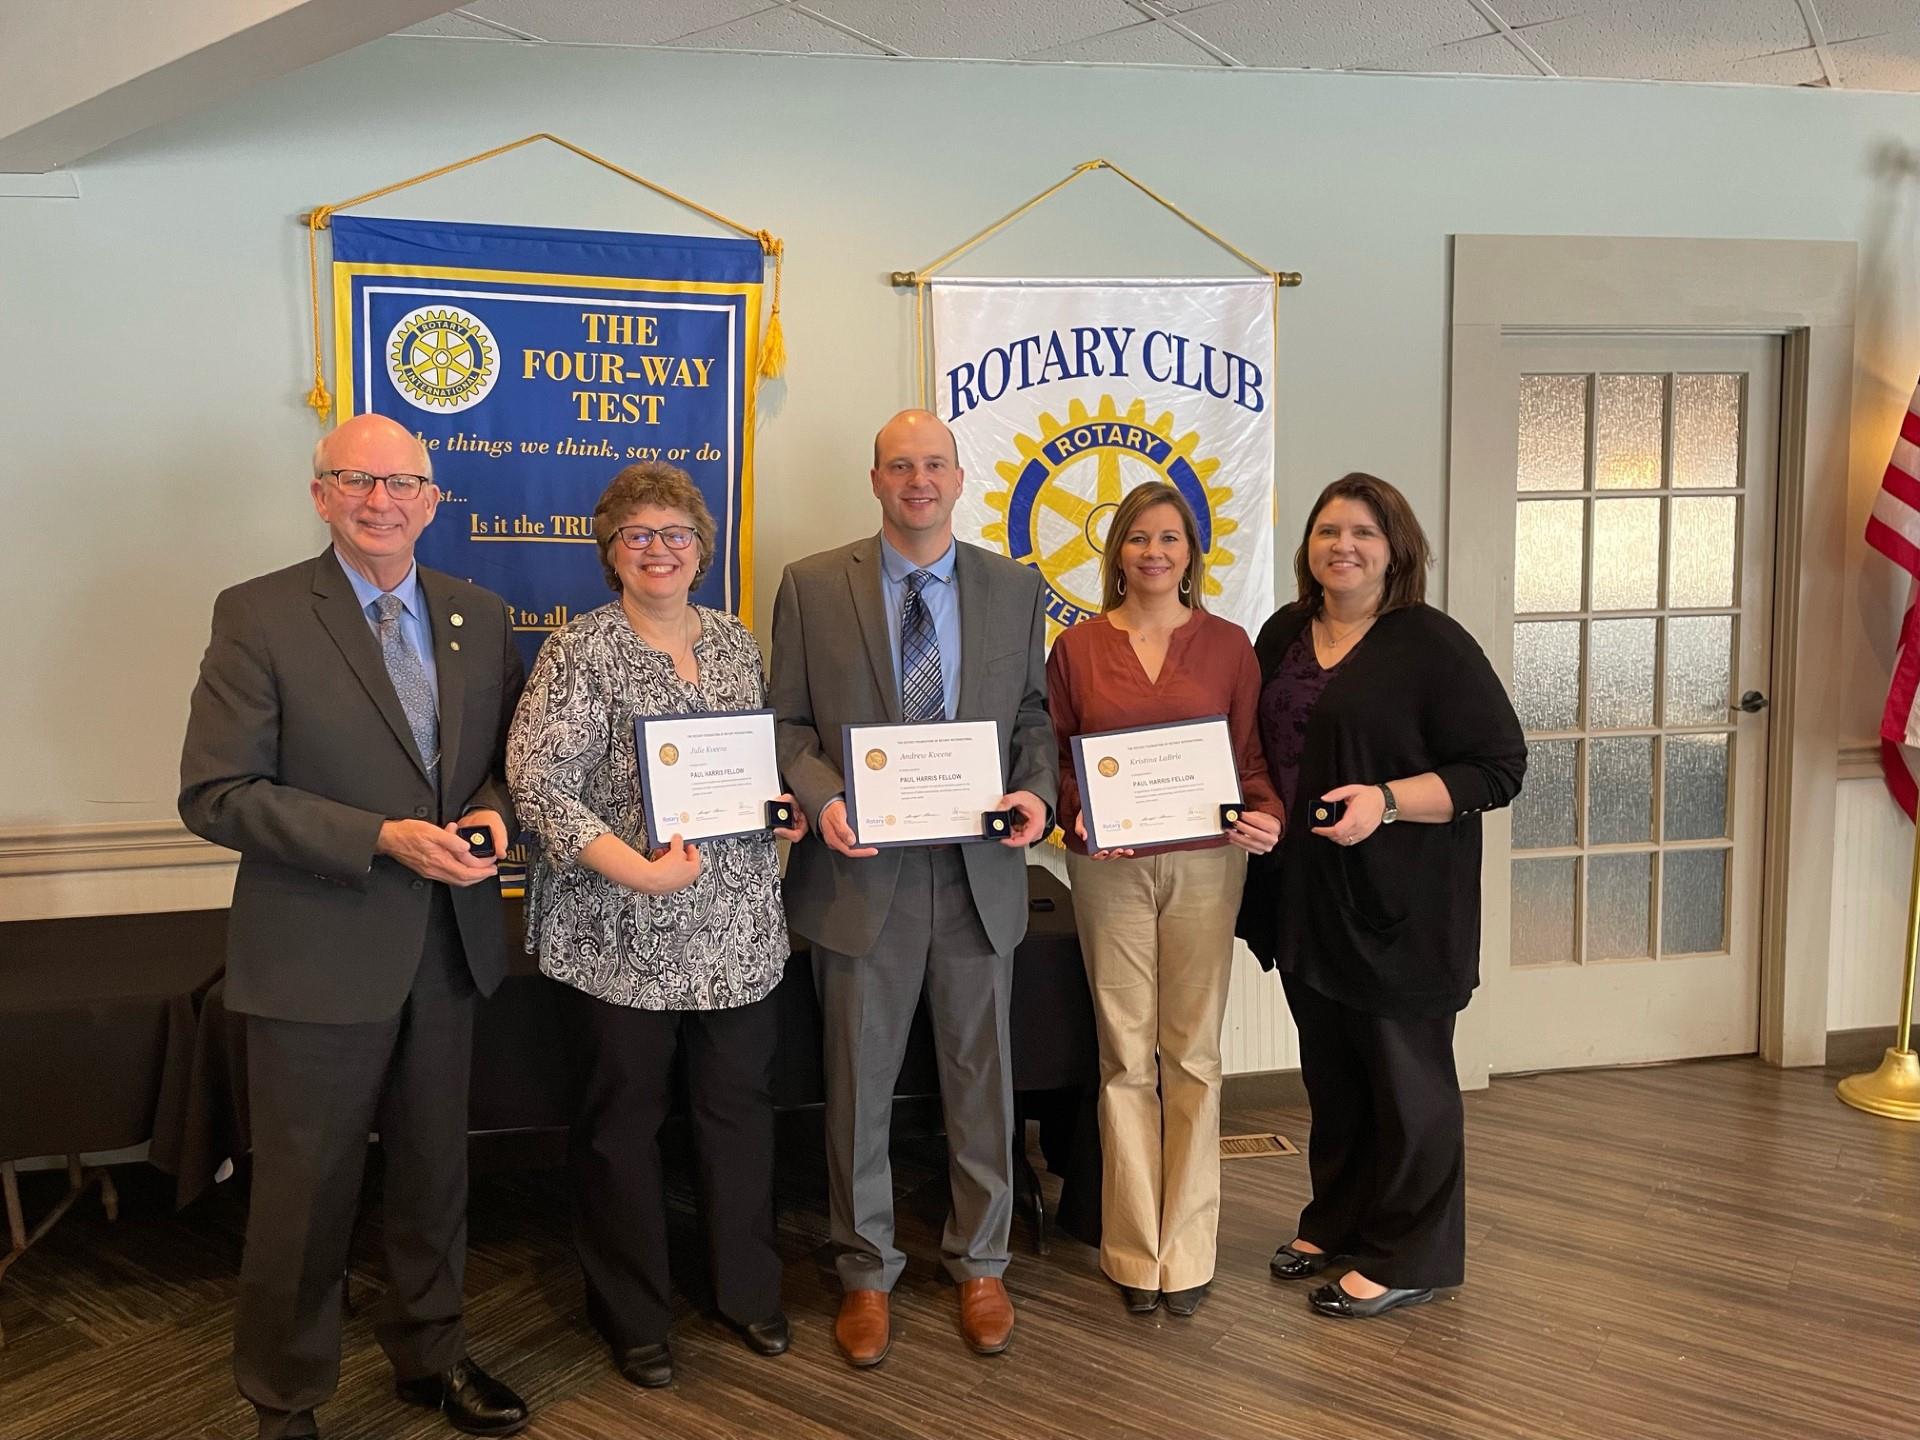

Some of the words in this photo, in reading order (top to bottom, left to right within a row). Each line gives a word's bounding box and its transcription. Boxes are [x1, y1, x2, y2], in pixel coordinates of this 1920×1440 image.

[422, 321, 464, 333] ROTARY
[581, 313, 658, 346] THE
[406, 369, 478, 397] INTERNATIONAL
[522, 349, 715, 388] FOUR-WAY
[946, 327, 1135, 423] ROTARY
[1143, 330, 1265, 413] CLUB
[572, 391, 665, 425] TEST
[415, 431, 441, 450] he
[447, 432, 513, 458] things
[520, 441, 549, 454] we
[556, 437, 620, 460] think,
[626, 446, 661, 464] say
[667, 448, 690, 460] or
[696, 442, 721, 461] do
[1054, 425, 1161, 458] ROTARY
[470, 513, 488, 534] Is
[494, 515, 508, 534] it
[514, 514, 545, 534] the
[550, 515, 596, 537] TRU
[520, 609, 538, 625] to
[544, 605, 568, 626] all
[916, 774, 937, 782] HARRIS
[938, 773, 962, 781] FELLOW
[1149, 777, 1170, 785] HARRIS
[1171, 774, 1195, 783] FELLOW
